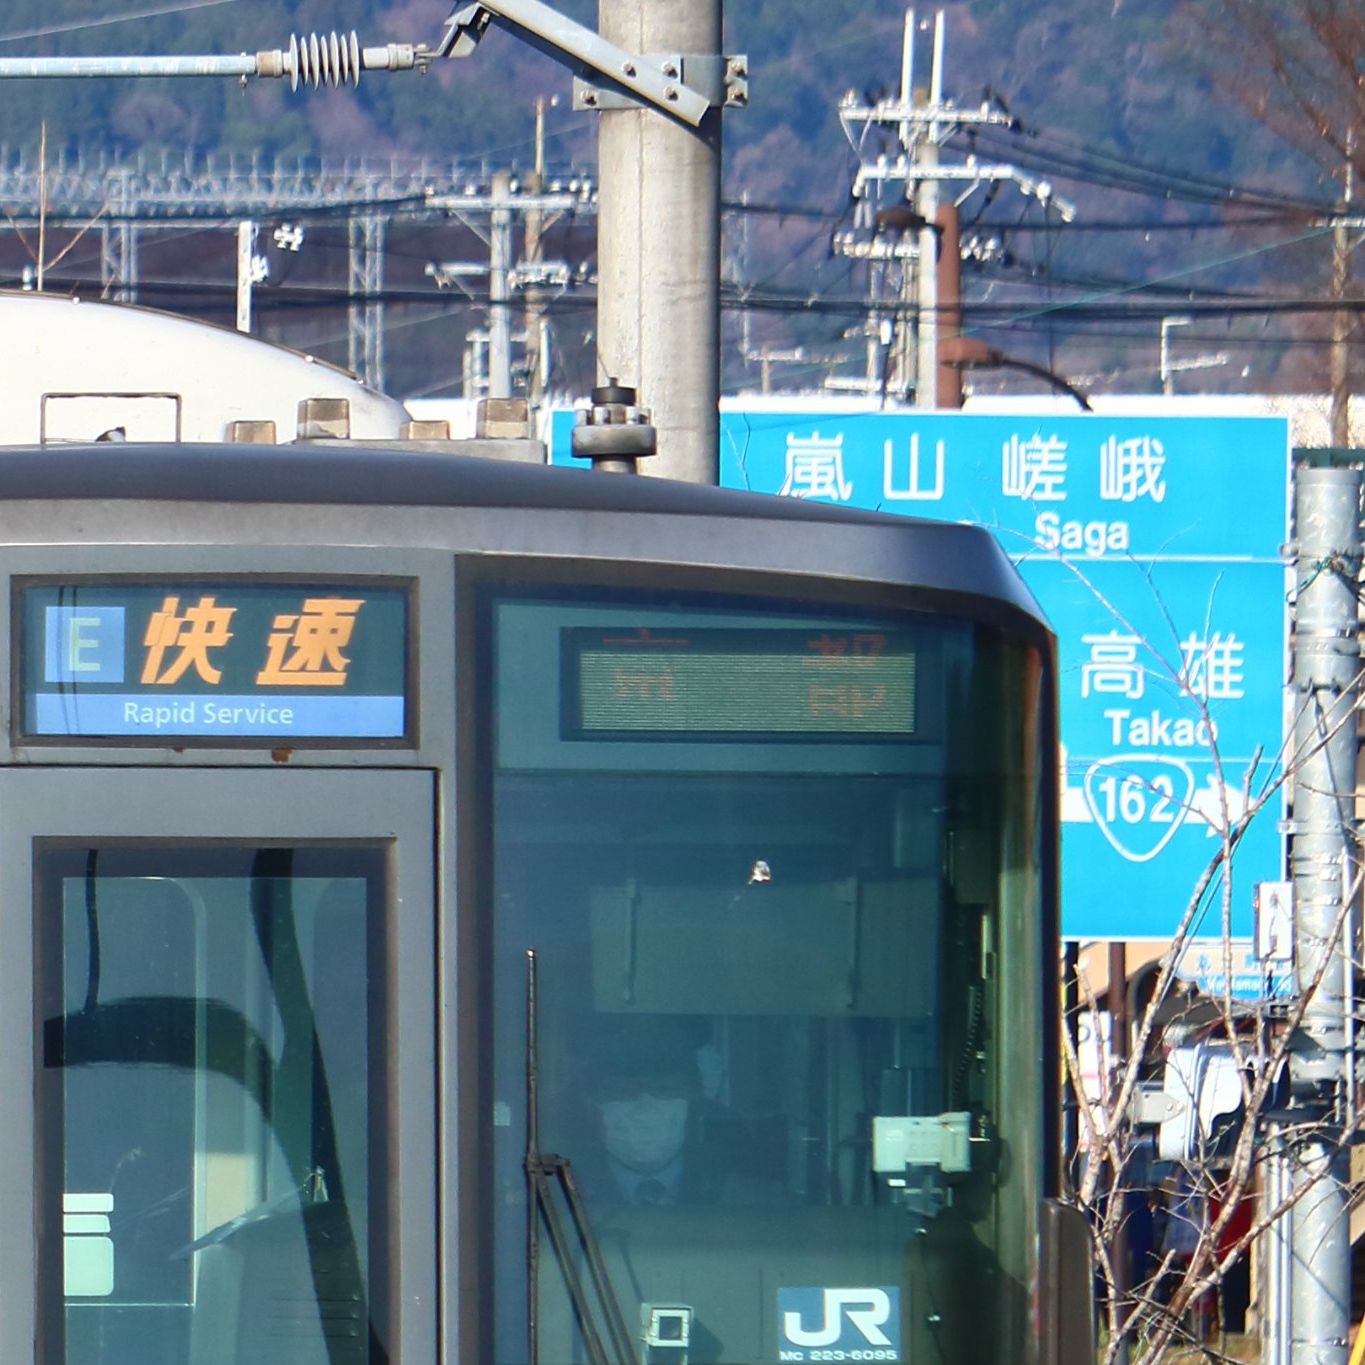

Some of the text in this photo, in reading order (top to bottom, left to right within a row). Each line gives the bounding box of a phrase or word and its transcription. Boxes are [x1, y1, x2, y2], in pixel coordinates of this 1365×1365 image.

[784, 432, 1167, 502] 嵐山 嵯峨
[1034, 512, 1130, 555] Saga
[70, 617, 101, 672] E
[140, 595, 366, 686] 快速
[1080, 630, 1245, 701] 高雄
[124, 702, 294, 728] Rapid Service
[1103, 710, 1218, 747] Takao
[1098, 780, 1175, 824] 162
[784, 1288, 892, 1347] JR
[810, 1349, 898, 1361] 223-6095
